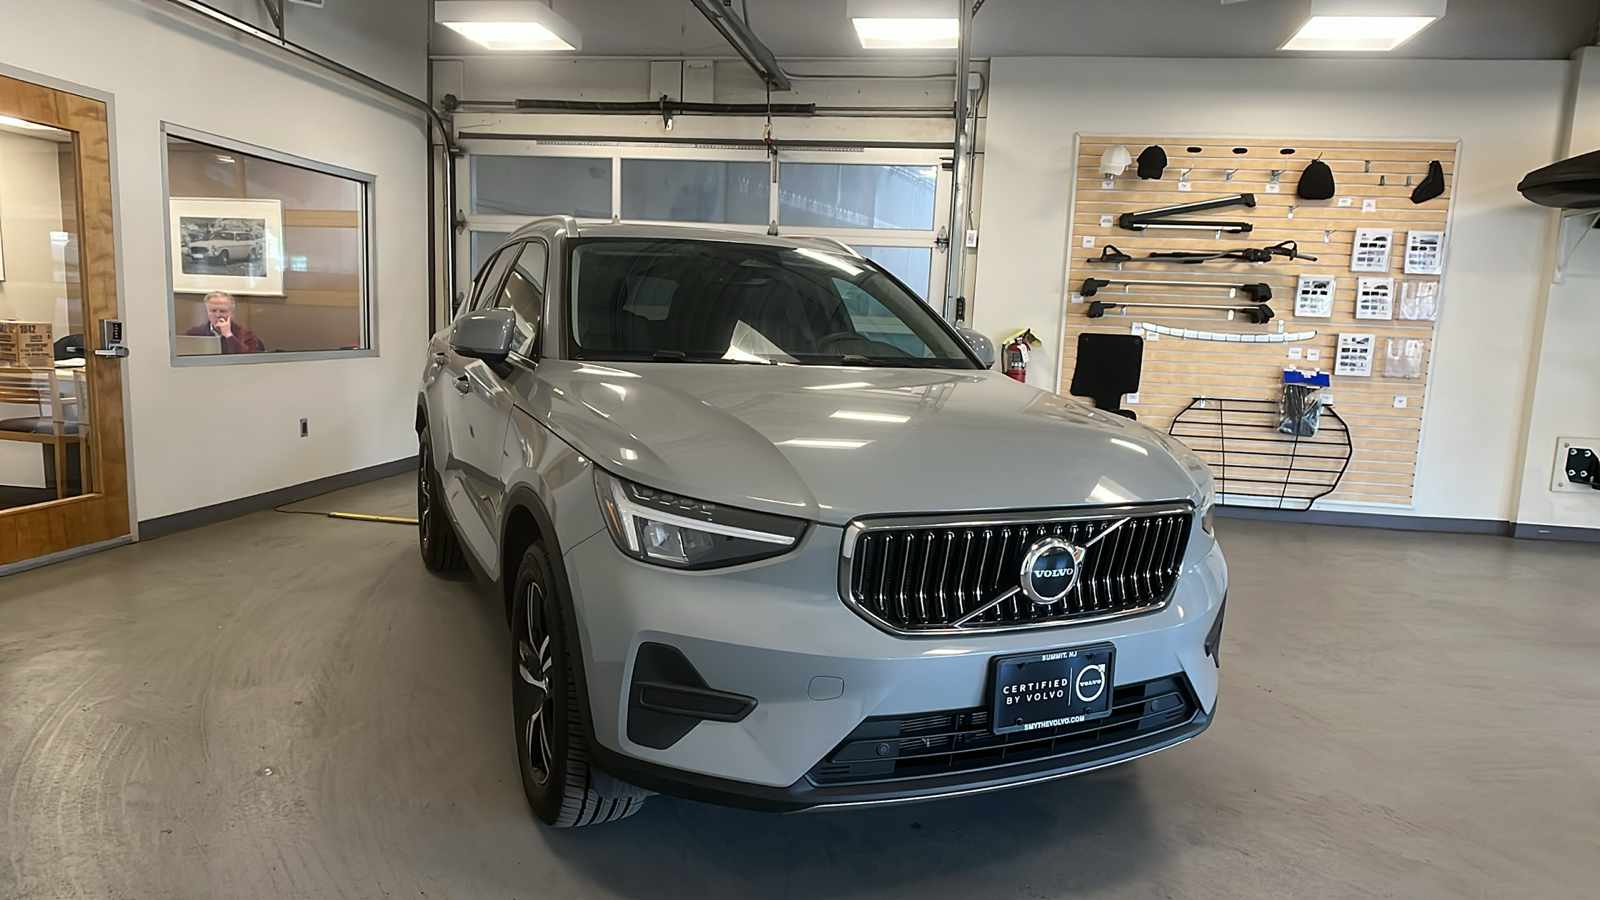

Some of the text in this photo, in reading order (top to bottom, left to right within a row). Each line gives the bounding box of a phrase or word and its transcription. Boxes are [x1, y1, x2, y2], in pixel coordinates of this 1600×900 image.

[1034, 568, 1074, 578] VOLVO
[1003, 678, 1068, 694] CERTIFIED
[1080, 679, 1101, 687] VOLVO
[1006, 690, 1064, 705] BY VOLVO
[1024, 715, 1085, 731] SMYTHEVOLVO.COM
